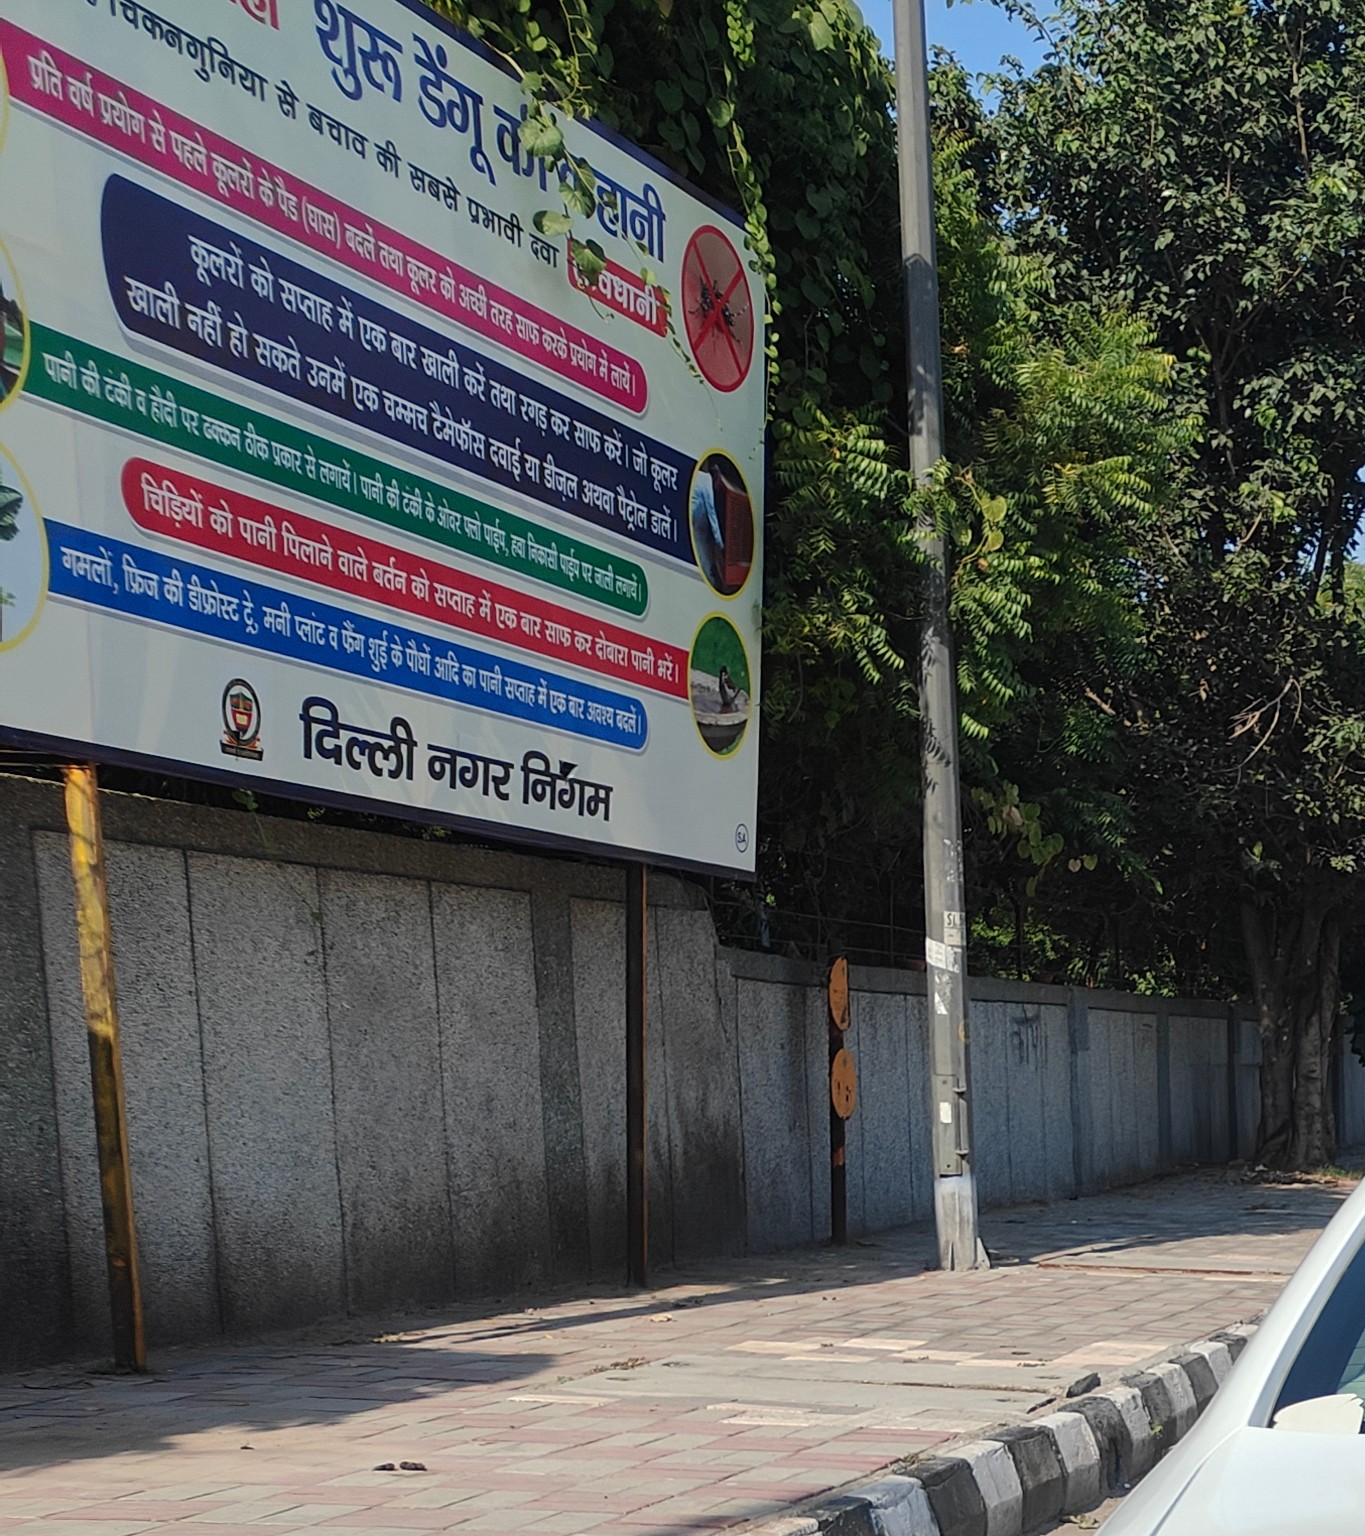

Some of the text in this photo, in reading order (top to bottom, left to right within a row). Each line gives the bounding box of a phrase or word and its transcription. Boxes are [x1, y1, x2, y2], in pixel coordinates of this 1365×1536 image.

[274, 80, 299, 119] से
[306, 103, 369, 159] बचाव
[373, 140, 401, 177] की
[407, 162, 461, 211] सबसे
[466, 196, 524, 247] प्रभावी
[529, 232, 560, 268] दवा
[411, 32, 497, 186] डेंगू
[27, 49, 63, 100] प्रति
[65, 71, 94, 117] वर्ष
[97, 90, 145, 143] प्रयोग
[147, 109, 166, 154] से
[168, 129, 208, 175] पहले
[257, 167, 274, 207] के
[273, 175, 298, 221] पैड
[301, 196, 340, 249] (घास)
[377, 240, 404, 276] तथा
[405, 255, 437, 295] कूलर
[438, 266, 455, 303] को
[458, 284, 487, 319] अच्छी
[489, 299, 513, 334] तरह
[514, 313, 539, 345] साफ
[541, 327, 567, 359] करके
[569, 338, 596, 376] प्रयोग
[598, 349, 608, 381] में
[124, 276, 180, 329] खाली
[184, 300, 222, 347] नहीं
[226, 311, 248, 358] हो
[252, 333, 300, 380] सकते
[305, 356, 346, 399] उनमें
[350, 376, 379, 411] एक
[382, 390, 428, 434] चम्मच
[488, 437, 521, 481] दवाई
[523, 453, 540, 483] या
[581, 479, 614, 515] अथवा
[188, 235, 243, 288] कूलरों
[248, 256, 274, 302] को
[278, 278, 333, 332] सप्ताह
[336, 295, 353, 339] में
[357, 316, 386, 352] एक
[389, 331, 416, 369] बार
[420, 346, 459, 388] खाली
[462, 362, 486, 401] करें
[489, 379, 516, 415] तथा
[519, 394, 547, 436] रगड़
[549, 409, 570, 440] कर
[572, 420, 601, 452] साफ
[632, 441, 647, 476] जो
[650, 457, 678, 493] कूलर
[42, 351, 77, 388] पानी
[80, 360, 100, 397] की
[103, 370, 132, 409] टंकी
[134, 389, 147, 414] व
[179, 406, 199, 435] पर
[201, 414, 240, 450] ढक्कन
[243, 422, 269, 459] ठीक
[271, 441, 302, 473] प्रकार
[304, 445, 316, 479] से
[360, 473, 384, 504] पानी
[385, 479, 399, 509] की
[401, 486, 422, 518] टंकी
[424, 492, 435, 521] के
[463, 511, 481, 540] फ्लो
[510, 534, 525, 557] हवा
[527, 532, 557, 569] निकासी
[581, 562, 592, 583] पर
[594, 564, 613, 590] जाली
[60, 546, 119, 593] गमलों,
[122, 554, 159, 599] फ्रिज
[162, 568, 183, 606] की
[187, 574, 239, 621] डीफ्रोस्ट
[262, 602, 291, 636] मनी
[294, 612, 325, 644] प्लांट
[328, 626, 338, 649] व
[390, 635, 403, 666] के
[433, 651, 459, 684] आदि
[462, 664, 476, 687] का
[478, 665, 502, 695] पानी
[504, 677, 535, 706] सप्ताह
[537, 678, 549, 708] में
[549, 690, 566, 713] एक
[568, 695, 584, 719] बार
[587, 701, 614, 726] अवश्य
[141, 472, 203, 528] चिड़ियों
[208, 499, 233, 537] को
[237, 515, 277, 552] पानी
[281, 521, 333, 570] पिलाने
[337, 546, 368, 581] वाले
[372, 556, 407, 594] बर्तन
[410, 568, 430, 601] को
[433, 582, 475, 618] सप्ताह
[478, 589, 491, 621] में
[494, 603, 517, 628] एक
[520, 612, 541, 638] बार
[544, 620, 571, 646] साफ
[573, 630, 592, 655] कर
[594, 630, 628, 666] दोबारा
[630, 647, 654, 675] पानी
[299, 697, 417, 781] दिल्ली
[427, 743, 514, 800] नगर
